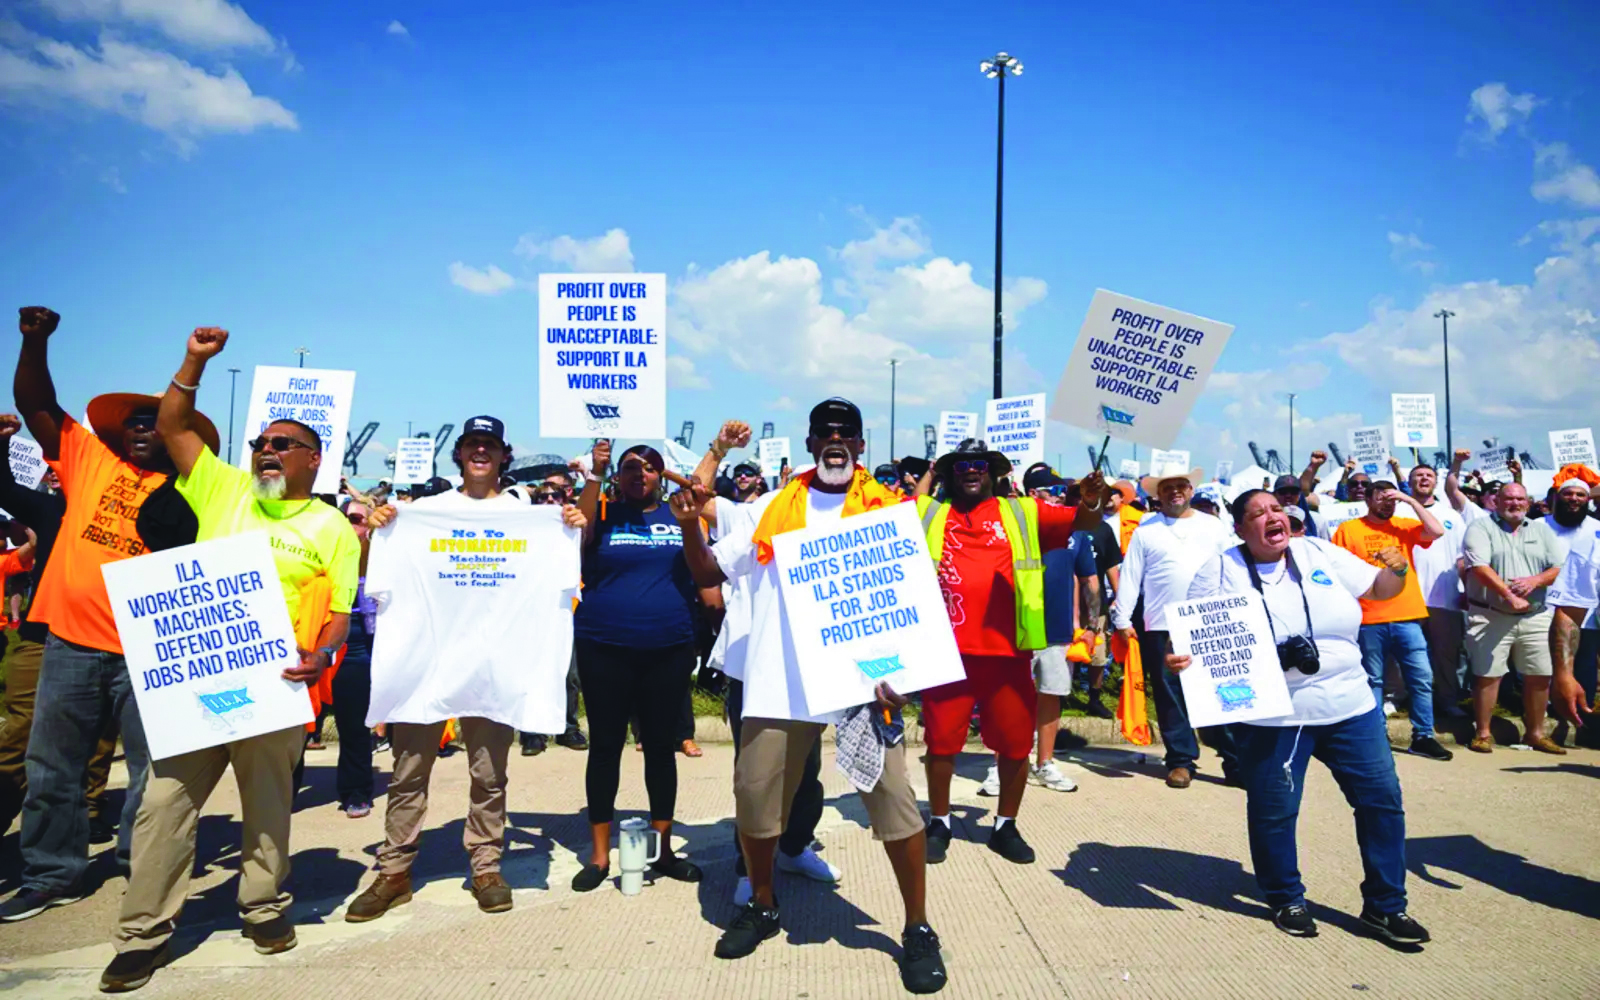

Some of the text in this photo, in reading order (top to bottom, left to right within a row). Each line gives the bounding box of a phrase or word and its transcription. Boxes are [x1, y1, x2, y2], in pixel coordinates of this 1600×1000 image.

[557, 282, 646, 299] PROFIT OVER
[567, 305, 636, 321] PEOPLE IS
[1111, 307, 1204, 346] PROFIT OVER
[547, 328, 658, 345] UNACCEPTABLE:
[1113, 327, 1186, 360] PEOPLE IS
[557, 350, 647, 367] SUPPORT ILA
[1087, 337, 1198, 381] UNACCEPTABLE:
[567, 373, 637, 390] WORKERS
[1090, 356, 1180, 393] SUPPORT ILA
[288, 378, 319, 391] FIGHT
[1095, 375, 1163, 405] WORKERS
[265, 392, 336, 409] AUTOMATION,
[996, 399, 1034, 411] CORPORATE
[268, 407, 329, 422] SAVE JOBS:
[987, 423, 1014, 433] WORKER
[1003, 431, 1037, 442] DEMANDS
[106, 484, 137, 502] FEED
[98, 495, 140, 521] FAMIL
[92, 511, 117, 528] NOT
[452, 529, 505, 538] No To
[800, 520, 898, 561] AUTOMATION
[429, 538, 528, 553] AUTOMATION!
[449, 554, 507, 563] Machines
[788, 538, 919, 585] HURTS FAMILIES:
[175, 559, 205, 584] ILA
[438, 571, 516, 579] have families
[471, 579, 501, 587] feed.
[813, 564, 905, 602] ILA STANDS
[127, 570, 264, 619] WORKERS OVER
[830, 588, 898, 620] FOR JOB
[1178, 596, 1249, 617] ILA WORKERS
[153, 599, 252, 639] MACHINES:
[820, 606, 919, 646] PROTECTION
[1201, 611, 1231, 626] OVER
[1190, 621, 1250, 641] MACHINES:
[154, 620, 262, 663] DEFEND OUR
[1190, 633, 1258, 656] DEFEND OUR
[143, 638, 288, 692] JOBS AND RIGHTS
[1202, 648, 1253, 667] JOBS AND
[1210, 662, 1250, 679] RIGHTS
